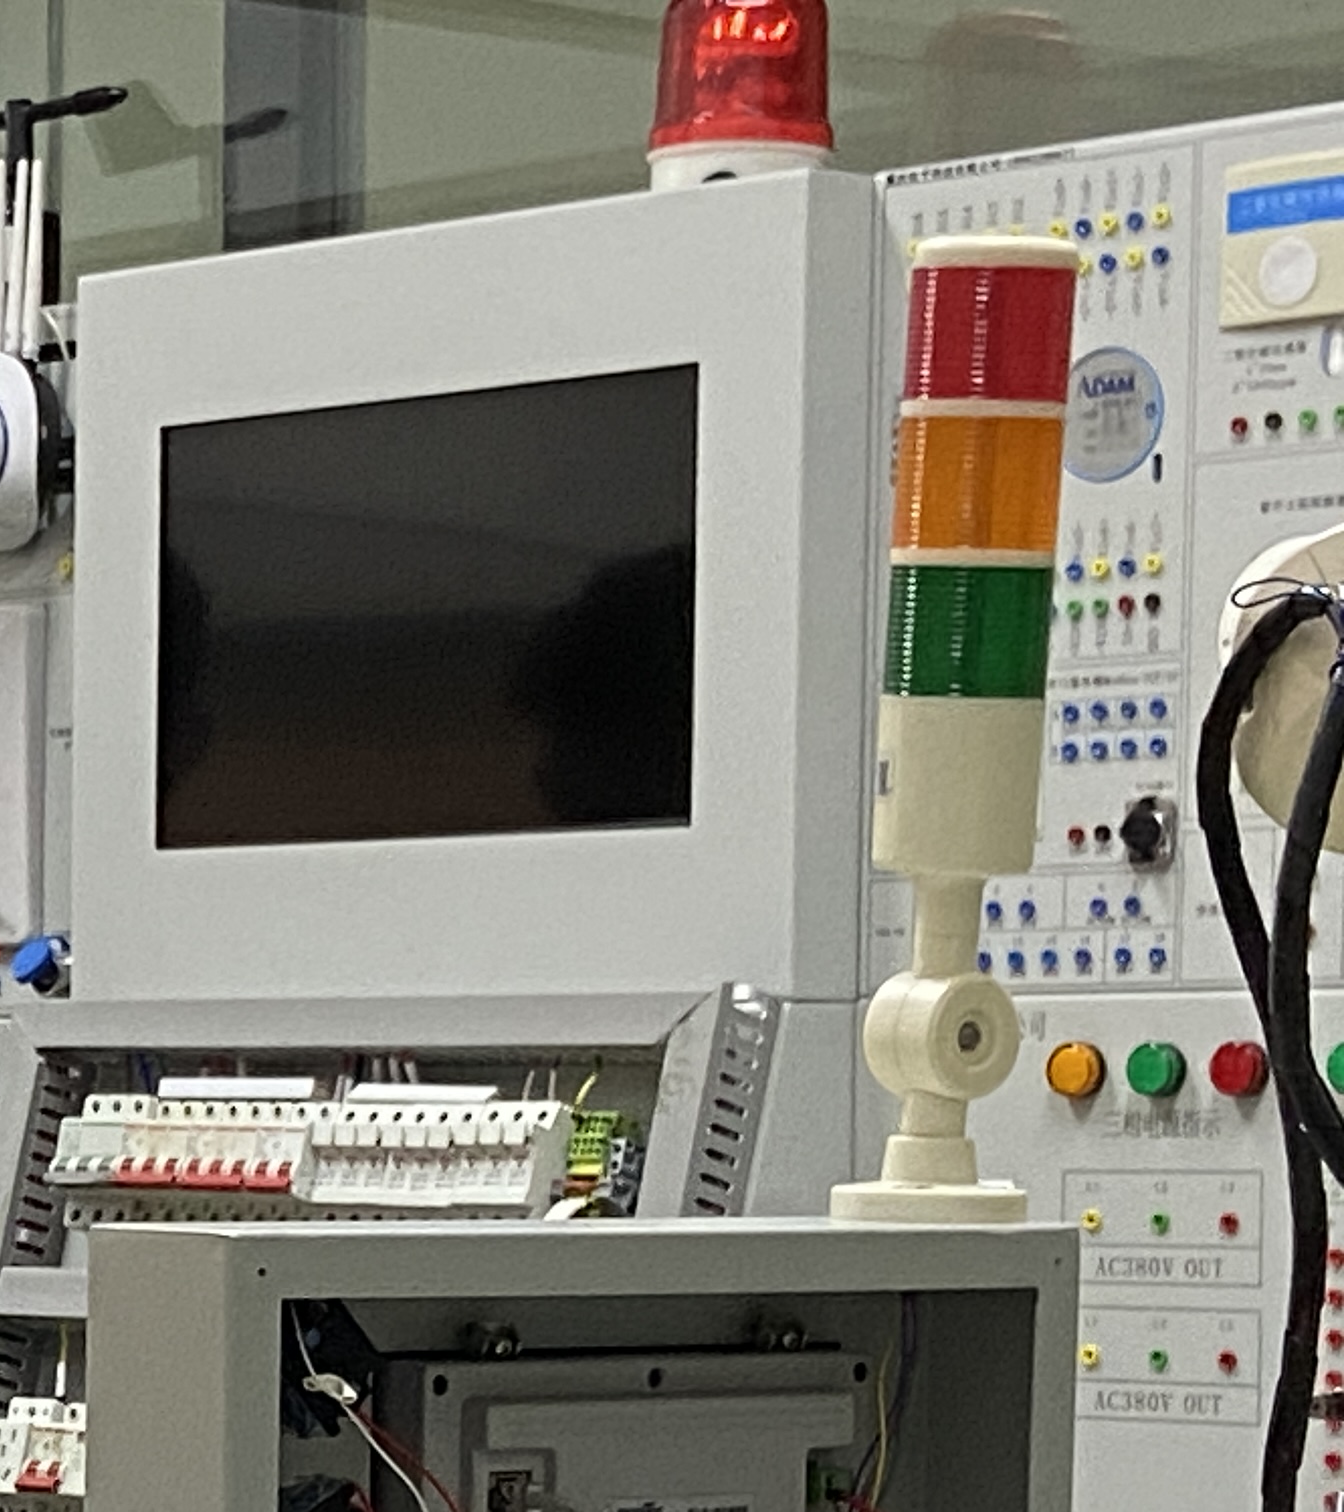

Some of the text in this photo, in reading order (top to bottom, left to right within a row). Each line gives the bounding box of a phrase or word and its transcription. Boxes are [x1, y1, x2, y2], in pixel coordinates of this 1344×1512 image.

[1095, 1256, 1225, 1279] AC380V OUT
[1094, 1389, 1224, 1417] AC380V OUT
